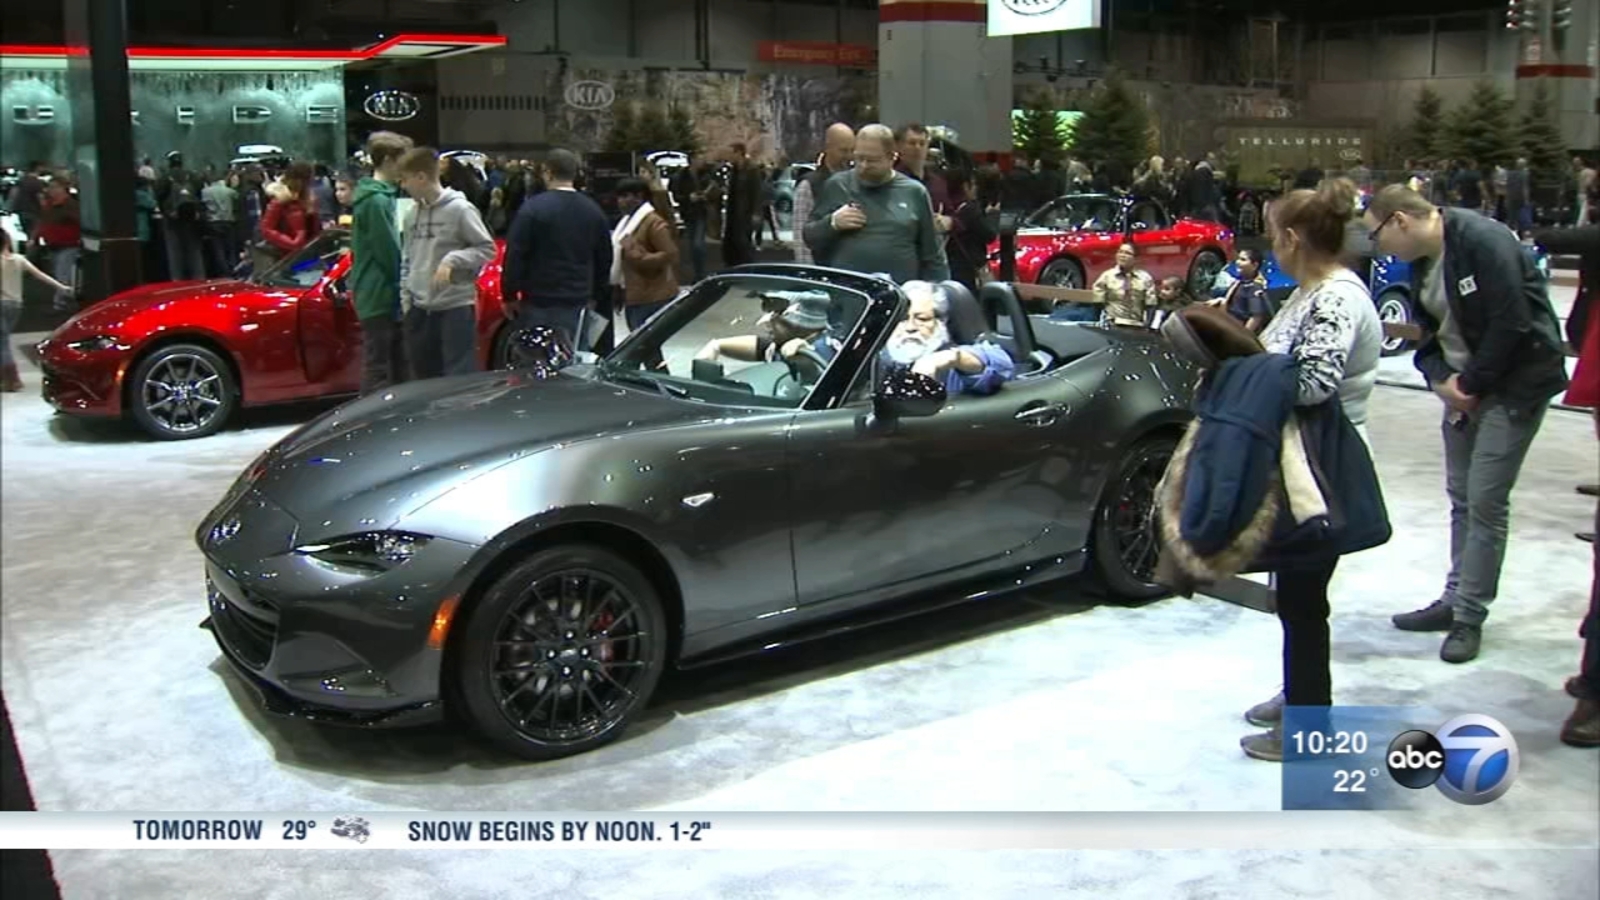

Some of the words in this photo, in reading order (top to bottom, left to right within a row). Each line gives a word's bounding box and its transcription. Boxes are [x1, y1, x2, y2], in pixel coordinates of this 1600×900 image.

[573, 86, 606, 104] KIA
[374, 95, 410, 114] KIA
[1239, 137, 1361, 146] TELLURIDE
